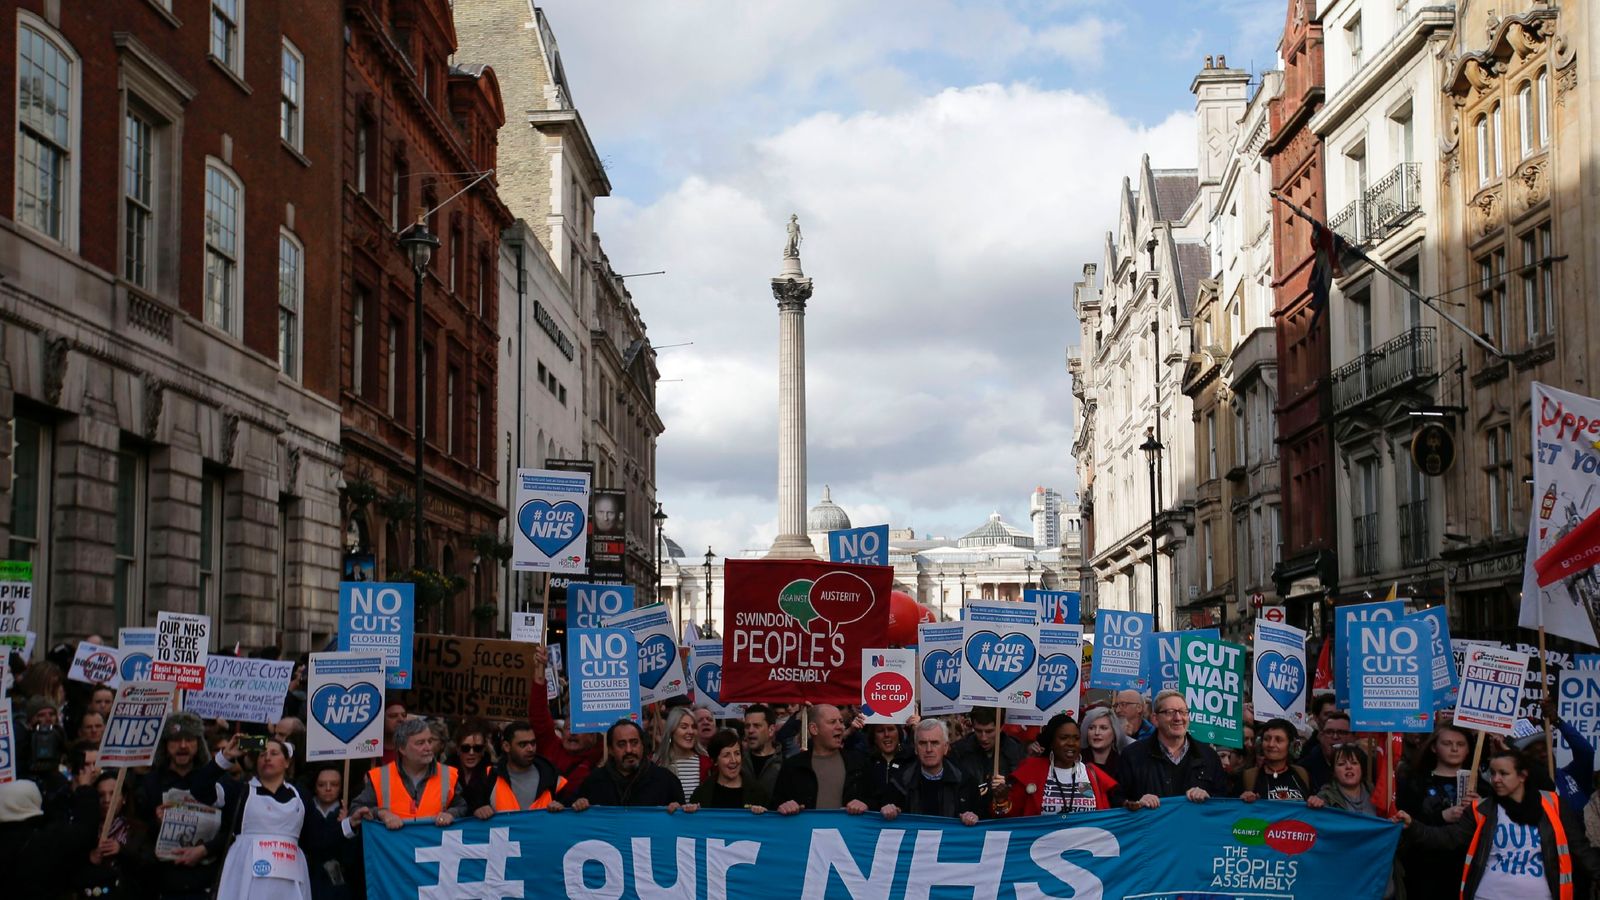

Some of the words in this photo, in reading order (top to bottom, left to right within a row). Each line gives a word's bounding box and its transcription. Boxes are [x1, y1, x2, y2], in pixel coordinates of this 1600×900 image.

[1571, 449, 1600, 474] YO
[546, 510, 575, 522] OUR
[530, 521, 574, 539] NHS
[839, 531, 880, 559] NO
[350, 588, 402, 615] NO
[577, 590, 622, 614] NO
[780, 594, 808, 603] AGAINST
[820, 591, 861, 602] AUSTERITY
[1254, 595, 1263, 604] M
[1036, 594, 1068, 618] NHS
[350, 616, 401, 632] CUTS
[736, 612, 794, 628] SWINDON
[1104, 614, 1144, 636] NO
[160, 620, 180, 635] OUR
[184, 622, 206, 638] NHS
[158, 634, 168, 648] IS
[172, 636, 198, 650] HERE
[351, 634, 399, 644] CLOSURES
[580, 633, 628, 660] NO
[1104, 634, 1142, 650] CUTS
[1362, 626, 1418, 654] NO
[157, 648, 170, 661] TO
[174, 650, 200, 664] STAY
[472, 643, 525, 670] faces
[638, 642, 664, 658] OUR
[994, 643, 1025, 655] OUR
[1103, 649, 1140, 658] CLOSURES
[1187, 640, 1240, 670] CUT
[154, 664, 172, 674] Resist
[172, 666, 182, 674] the
[221, 658, 259, 678] MORE
[260, 664, 290, 679] CUTS
[581, 660, 628, 676] CUTS
[978, 654, 1024, 672] NHS
[1039, 663, 1068, 676] OUR
[1280, 663, 1298, 677] OUR
[1362, 656, 1419, 673] CUTS
[153, 672, 167, 680] cuts
[167, 672, 177, 681] and
[178, 673, 202, 684] closures
[418, 667, 526, 697] umanitarian
[768, 668, 831, 682] ASSEMBLY
[1184, 664, 1240, 694] WAR
[1266, 672, 1298, 694] NHS
[1364, 676, 1416, 685] CLOSURES
[1468, 666, 1496, 681] SAVE
[1498, 671, 1520, 686] OUR
[582, 680, 628, 688] CLOSURES
[876, 682, 901, 692] Scrap
[1364, 688, 1418, 696] PRIVATISATION
[340, 693, 371, 706] OUR
[582, 691, 629, 699] PRIVATISATION
[871, 692, 886, 700] the
[889, 692, 908, 703] cap!
[1186, 686, 1238, 717] NOT
[1463, 681, 1516, 714] NHS
[116, 703, 143, 716] SAVE
[144, 703, 164, 716] OUR
[596, 702, 630, 710] RESTRAINT
[1364, 700, 1378, 708] PAY
[1380, 700, 1418, 708] RESTRAINT
[324, 704, 370, 724] NHS
[1188, 711, 1237, 730] WELFARE
[106, 718, 160, 746] NHS
[161, 823, 196, 841] NHS
[1232, 828, 1260, 836] AGAINST
[1267, 830, 1316, 842] AUSTERITY
[1222, 846, 1248, 858] THE
[562, 836, 762, 900] our
[800, 826, 1121, 900] NHS
[1213, 858, 1298, 878] PEOPLES
[1490, 850, 1544, 878] NHS
[1210, 874, 1297, 891] ASSEMBLY
